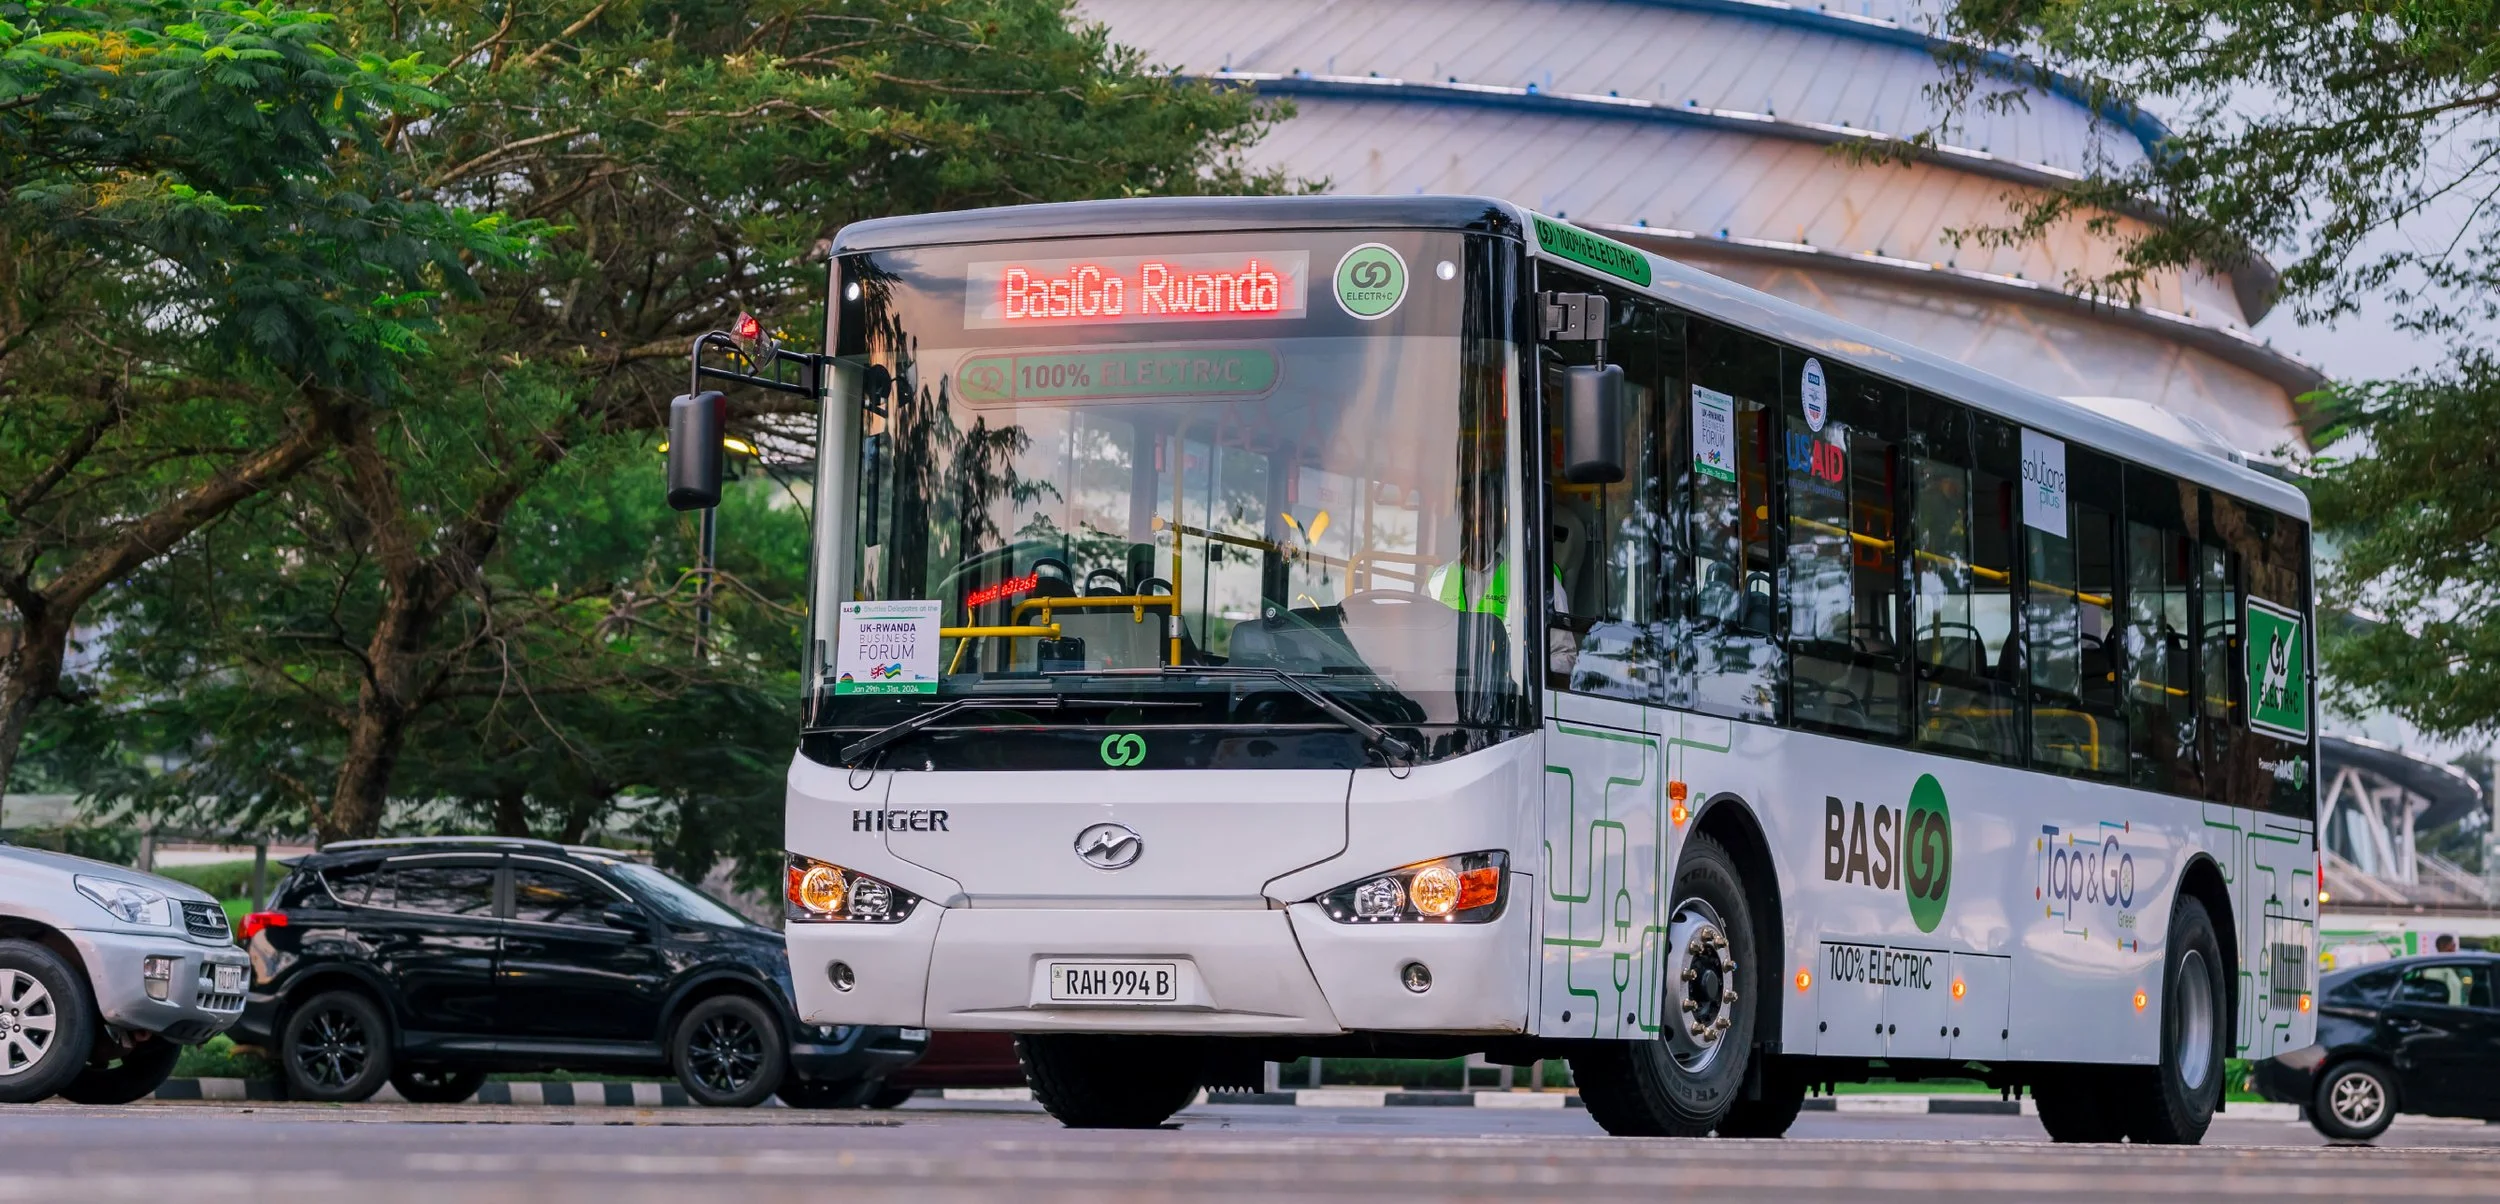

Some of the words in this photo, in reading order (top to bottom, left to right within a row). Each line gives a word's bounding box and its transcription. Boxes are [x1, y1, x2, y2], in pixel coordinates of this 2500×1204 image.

[1556, 227, 1586, 257] 100%
[1006, 265, 1123, 318] BasiGo
[1142, 261, 1278, 314] Rwanda
[1021, 364, 1090, 389] 100%
[1702, 428, 1725, 448] FORUM
[1786, 430, 1843, 482] USAID
[2040, 490, 2060, 513] plus
[860, 623, 916, 633] UK-RWANDA
[860, 633, 916, 643] BUSINESS
[859, 644, 914, 660] FORUM
[852, 685, 865, 694] Jan
[902, 685, 919, 693] 2024
[851, 809, 950, 832] HIGER
[2118, 910, 2136, 928] Green
[1830, 945, 1864, 983] 100%
[1869, 949, 1932, 990] ELECTRIC
[1066, 969, 1106, 996] RAH
[1111, 969, 1150, 996] 994
[1156, 969, 1170, 996] B
